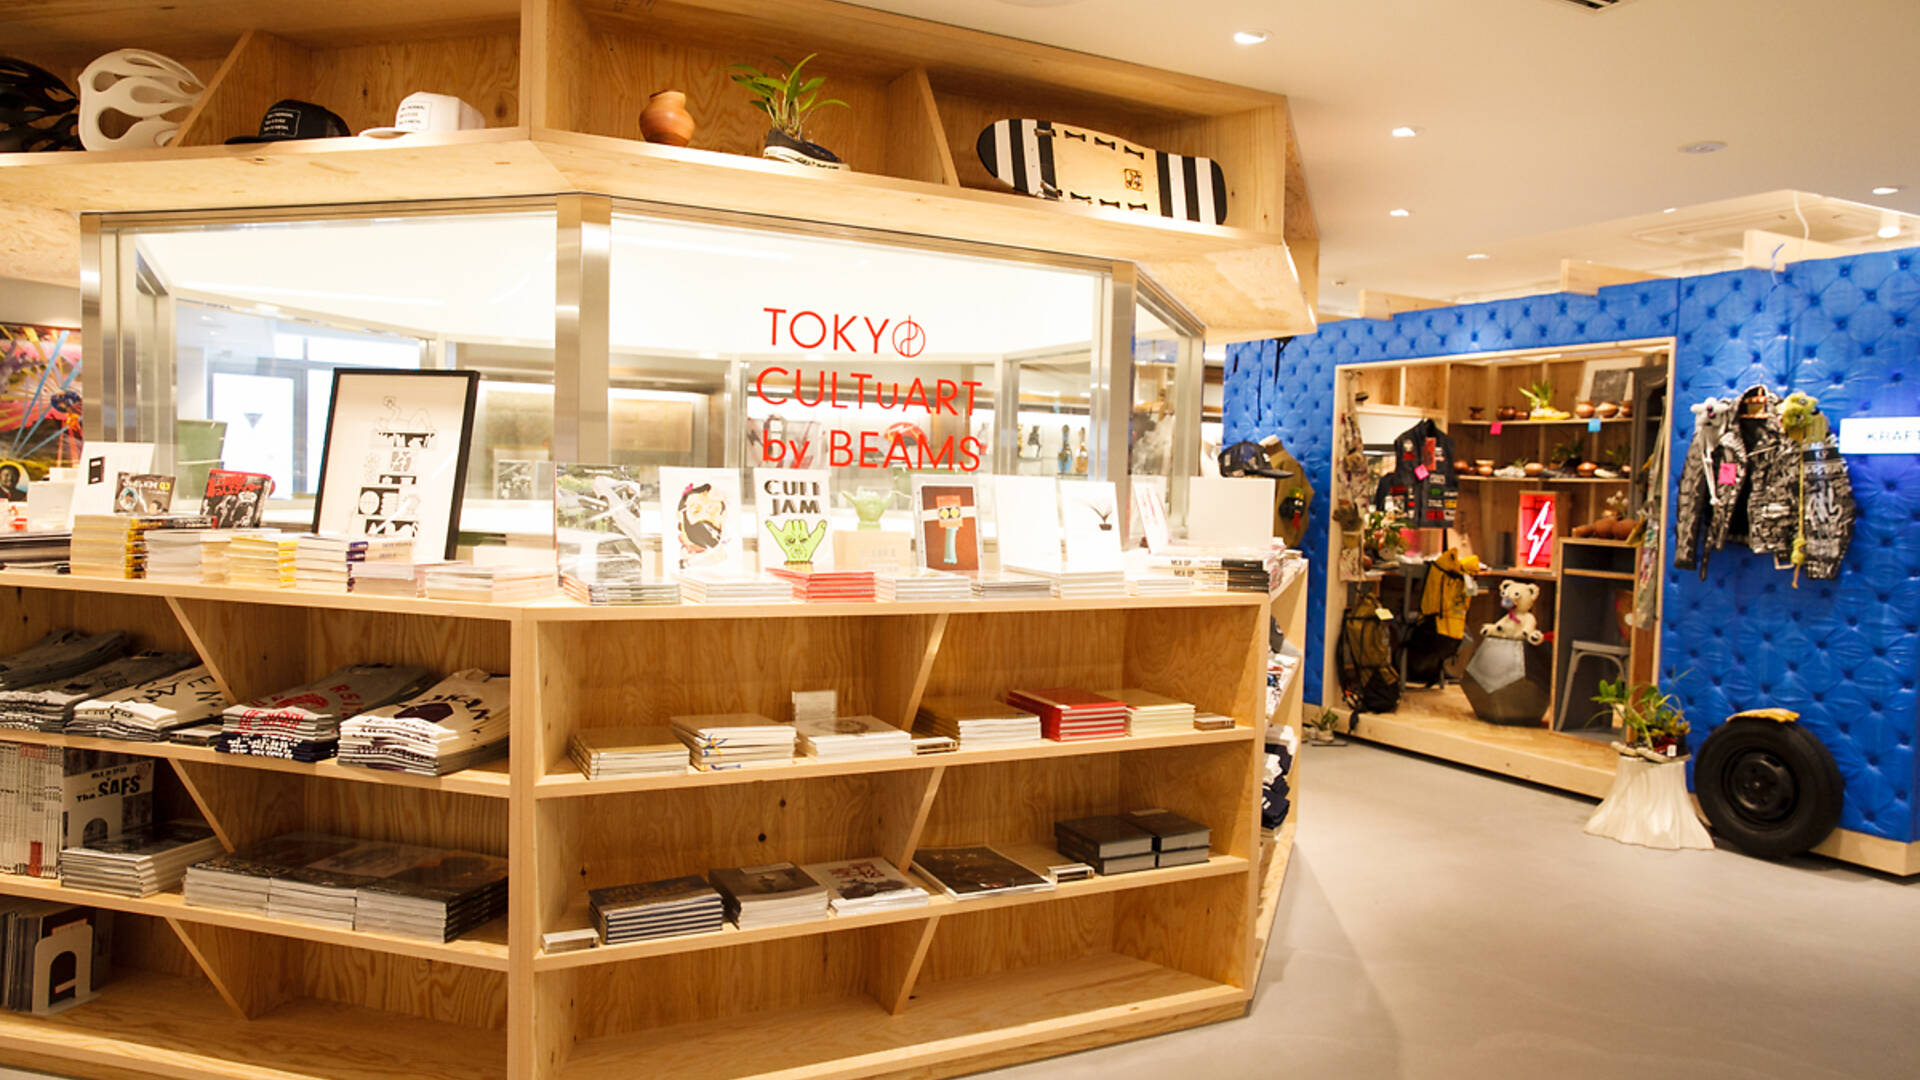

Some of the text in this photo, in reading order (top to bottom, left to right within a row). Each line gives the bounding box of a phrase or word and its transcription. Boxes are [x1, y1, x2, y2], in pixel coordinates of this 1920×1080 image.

[756, 366, 982, 417] CULTuART
[762, 429, 980, 472] by BEAMS
[769, 499, 821, 516] JAM
[76, 793, 96, 802] The
[98, 775, 141, 796] SAFS
